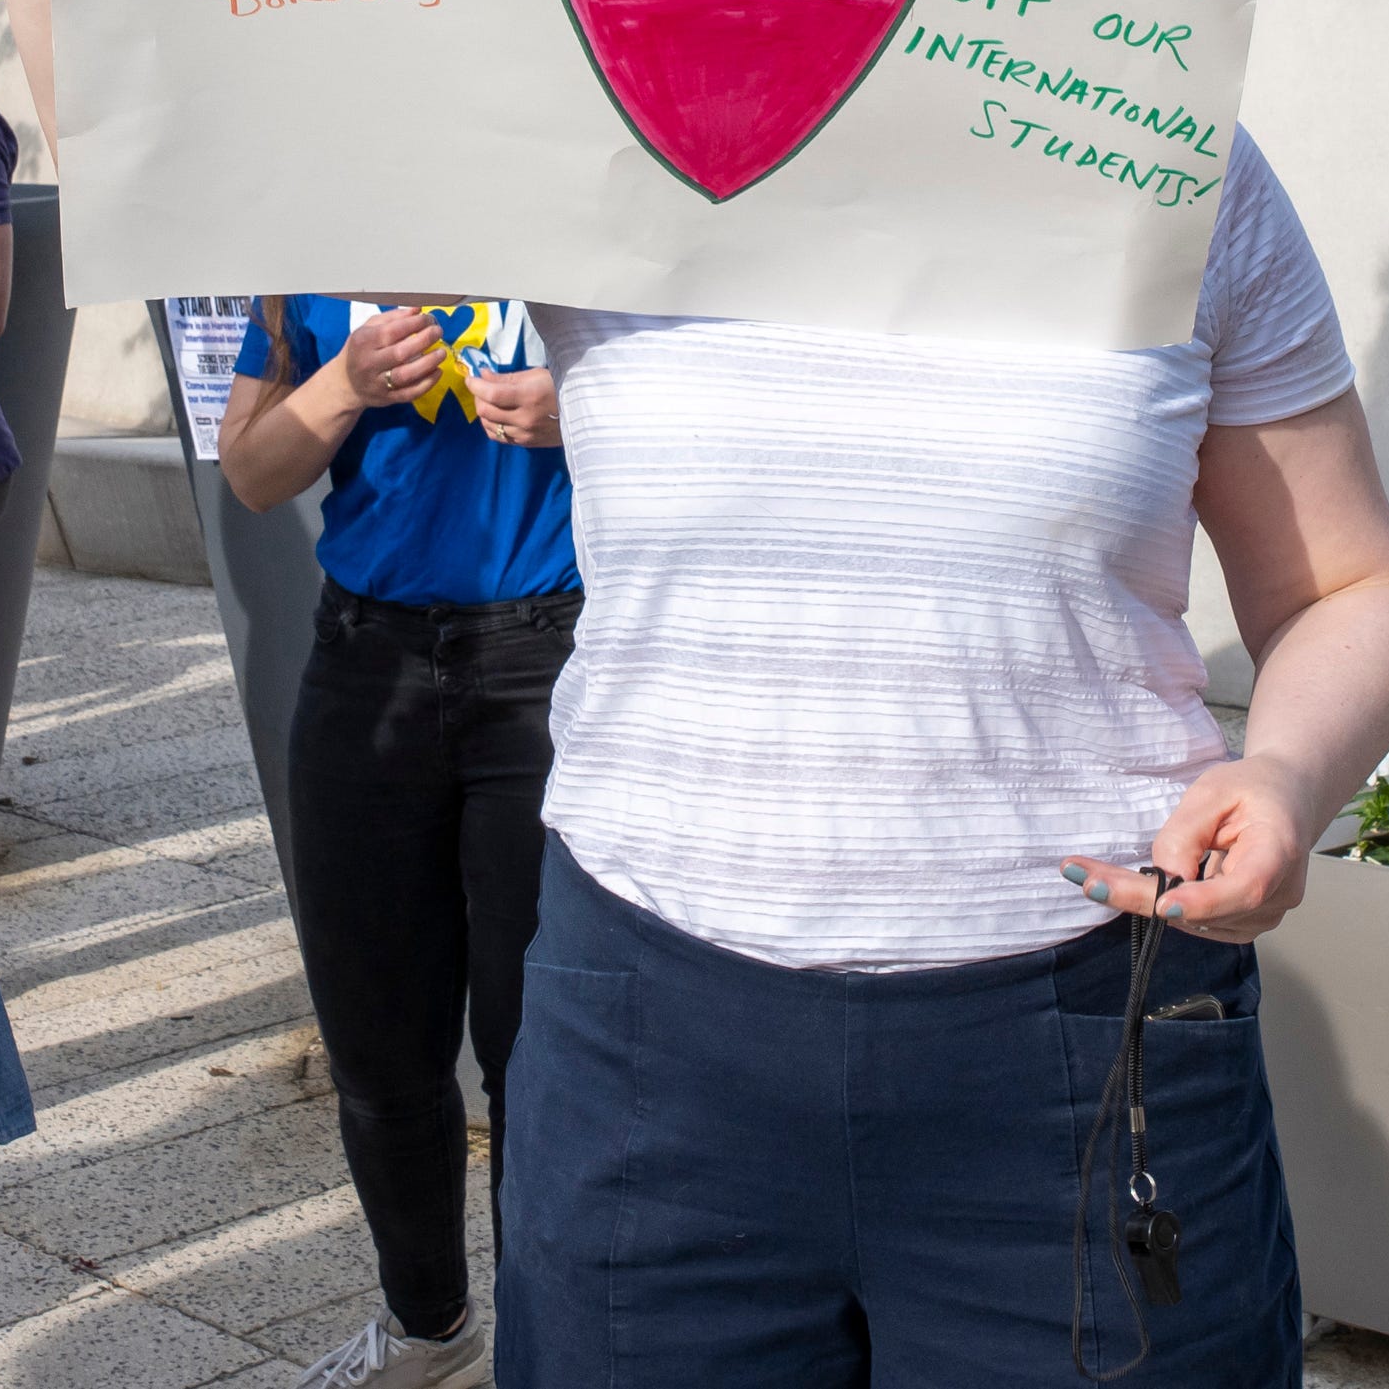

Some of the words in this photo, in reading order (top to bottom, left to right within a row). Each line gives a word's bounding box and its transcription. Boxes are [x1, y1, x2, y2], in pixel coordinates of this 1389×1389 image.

[1092, 13, 1193, 72] OUR
[904, 25, 1218, 158] INTERNATIONAL
[970, 99, 1222, 207] STUDENTS!
[178, 297, 213, 317] STAND
